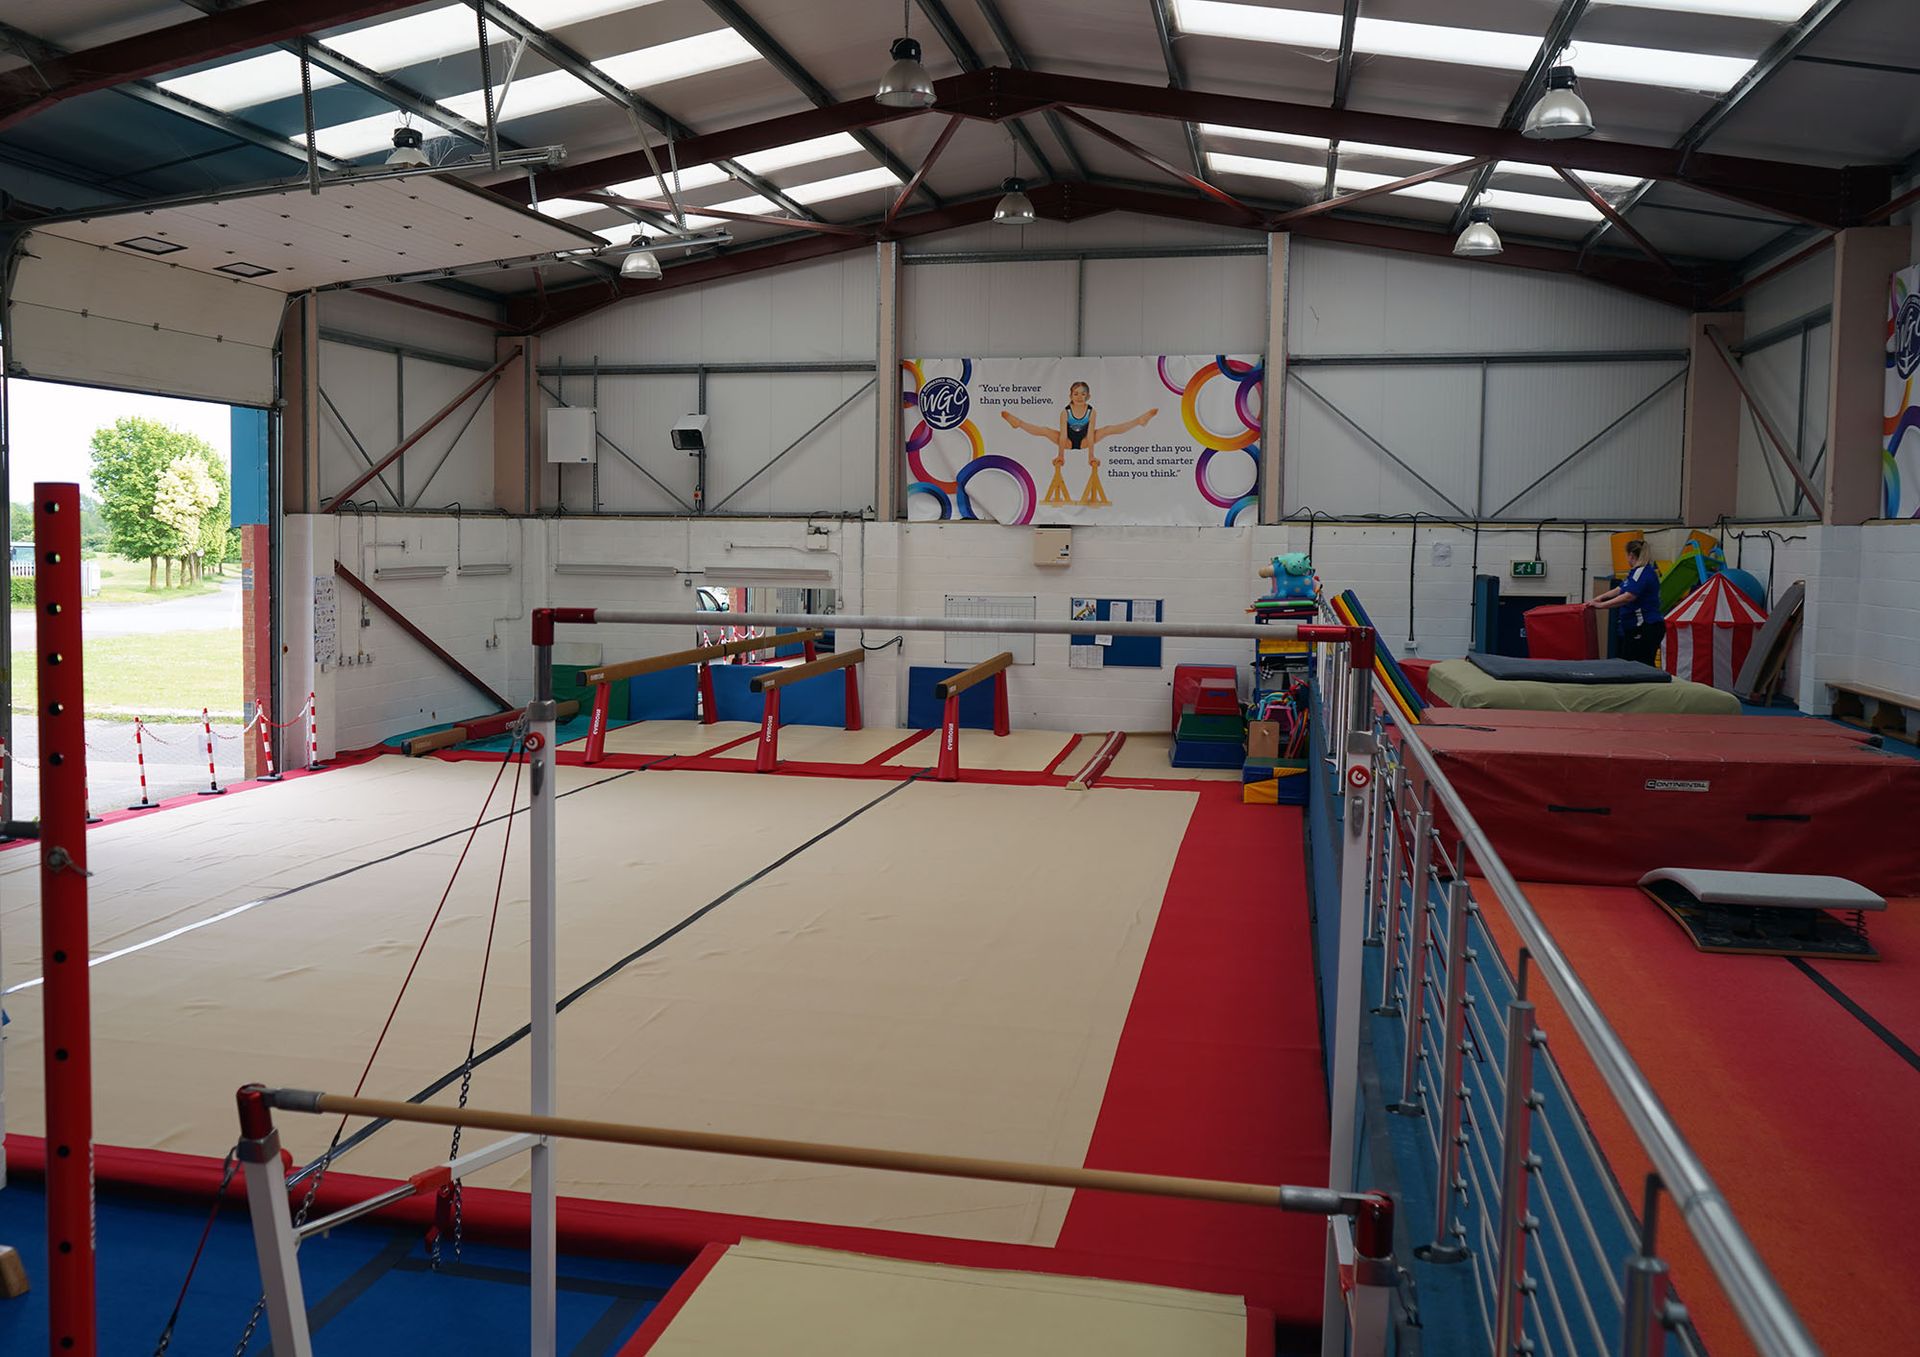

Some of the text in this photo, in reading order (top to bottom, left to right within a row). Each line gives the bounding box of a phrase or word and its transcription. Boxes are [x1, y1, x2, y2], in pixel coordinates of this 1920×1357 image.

[1012, 383, 1042, 393] braver
[920, 385, 968, 414] WGC
[979, 396, 1001, 405] than
[1002, 397, 1019, 407] you
[1108, 444, 1192, 455] stronger than you
[1108, 456, 1195, 466] seem, and smarter
[1107, 468, 1130, 478] than
[1131, 470, 1149, 480] you
[1646, 779, 1707, 789] CONTINENTAL
